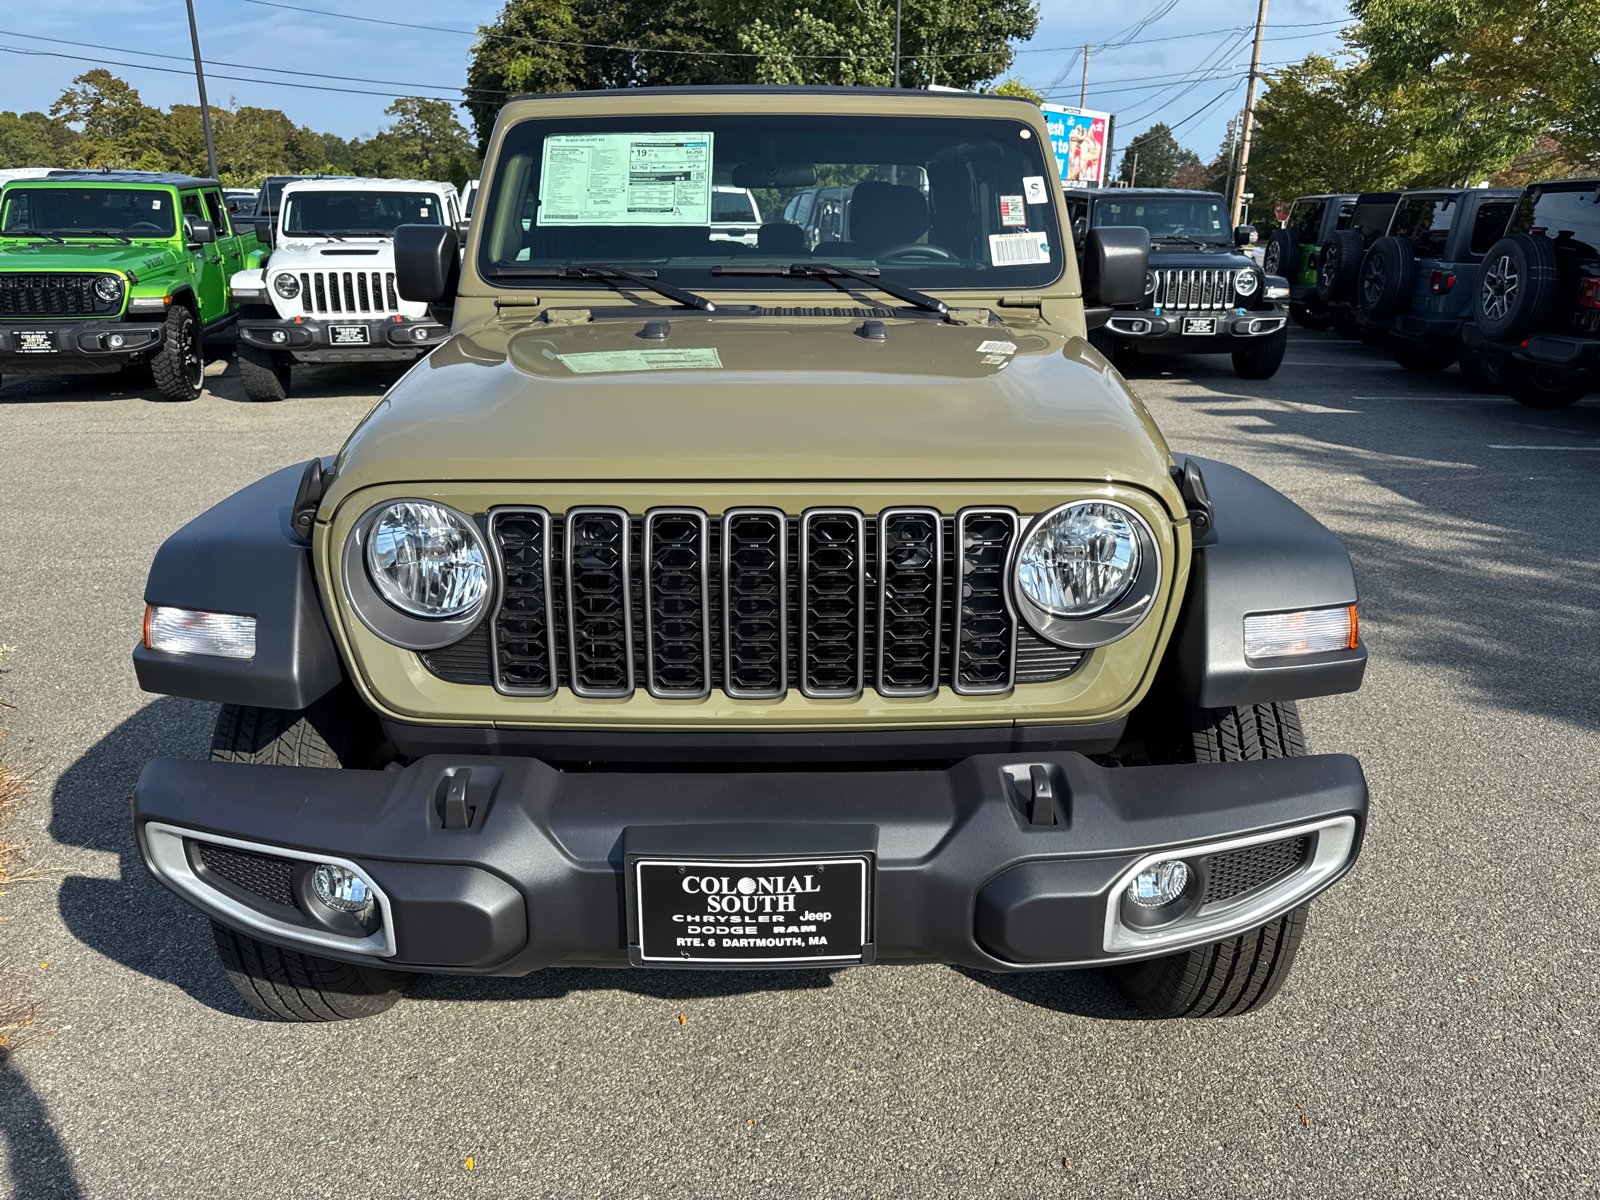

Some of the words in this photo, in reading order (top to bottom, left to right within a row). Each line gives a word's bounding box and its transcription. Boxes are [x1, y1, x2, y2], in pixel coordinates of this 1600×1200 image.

[636, 149, 647, 157] 19
[1058, 139, 1069, 154] to
[682, 875, 821, 895] COLONIAL
[707, 894, 796, 913] SOUTH
[672, 914, 785, 923] CHRYSLER
[799, 910, 832, 923] Jeep
[687, 925, 758, 935] DODGE
[773, 925, 817, 934] RAM
[676, 937, 705, 947] RTE.
[707, 938, 716, 947] 6
[722, 937, 806, 948] DARTMOUTH,
[808, 936, 828, 946] MA
